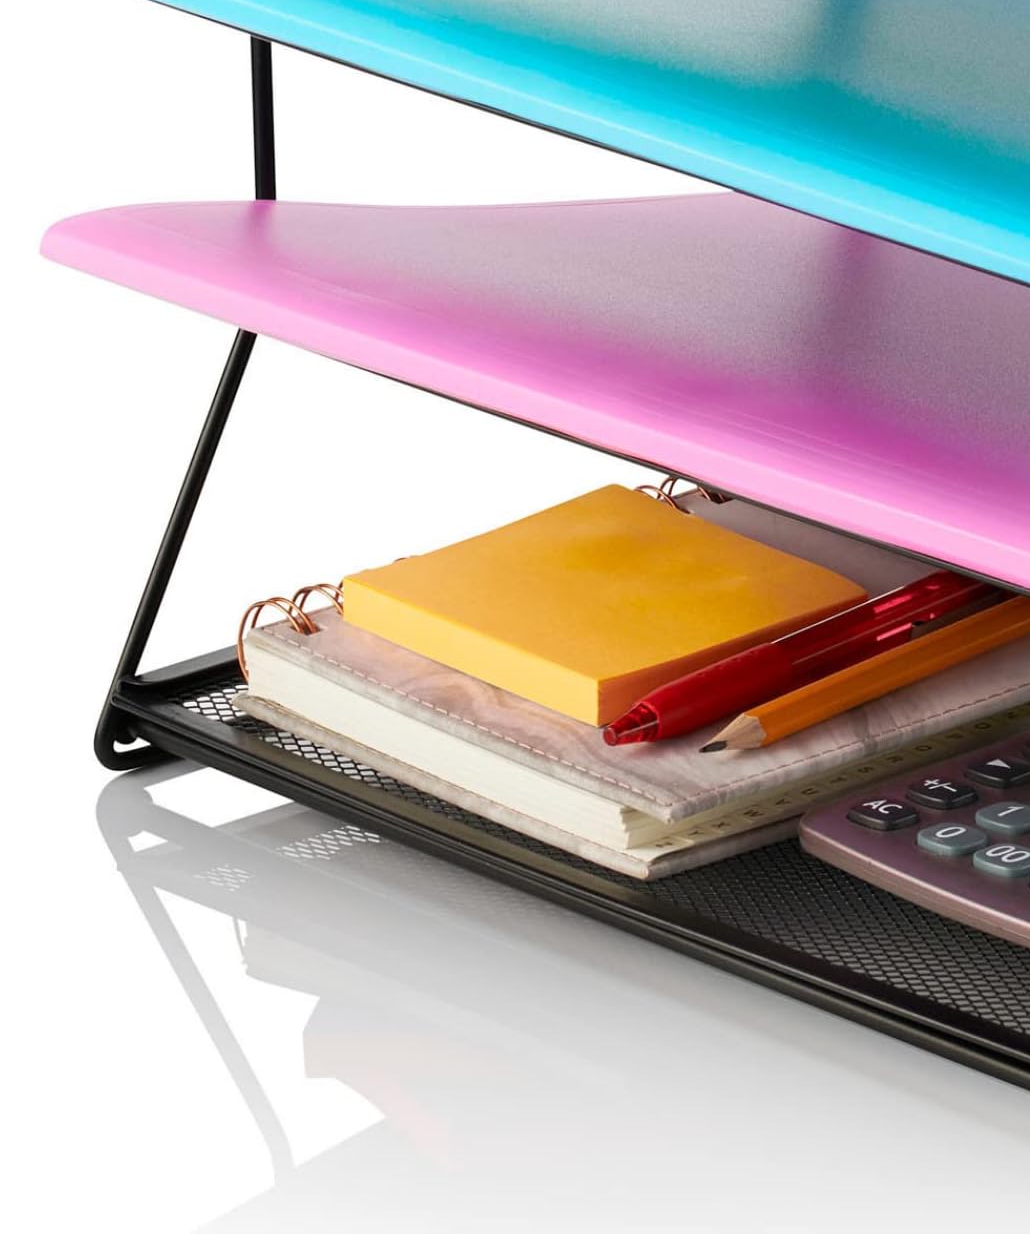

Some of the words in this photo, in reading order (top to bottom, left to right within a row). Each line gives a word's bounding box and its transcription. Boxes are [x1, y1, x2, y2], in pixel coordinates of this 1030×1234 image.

[863, 799, 902, 814] AC
[997, 806, 1024, 817] 1
[935, 826, 966, 838] 0
